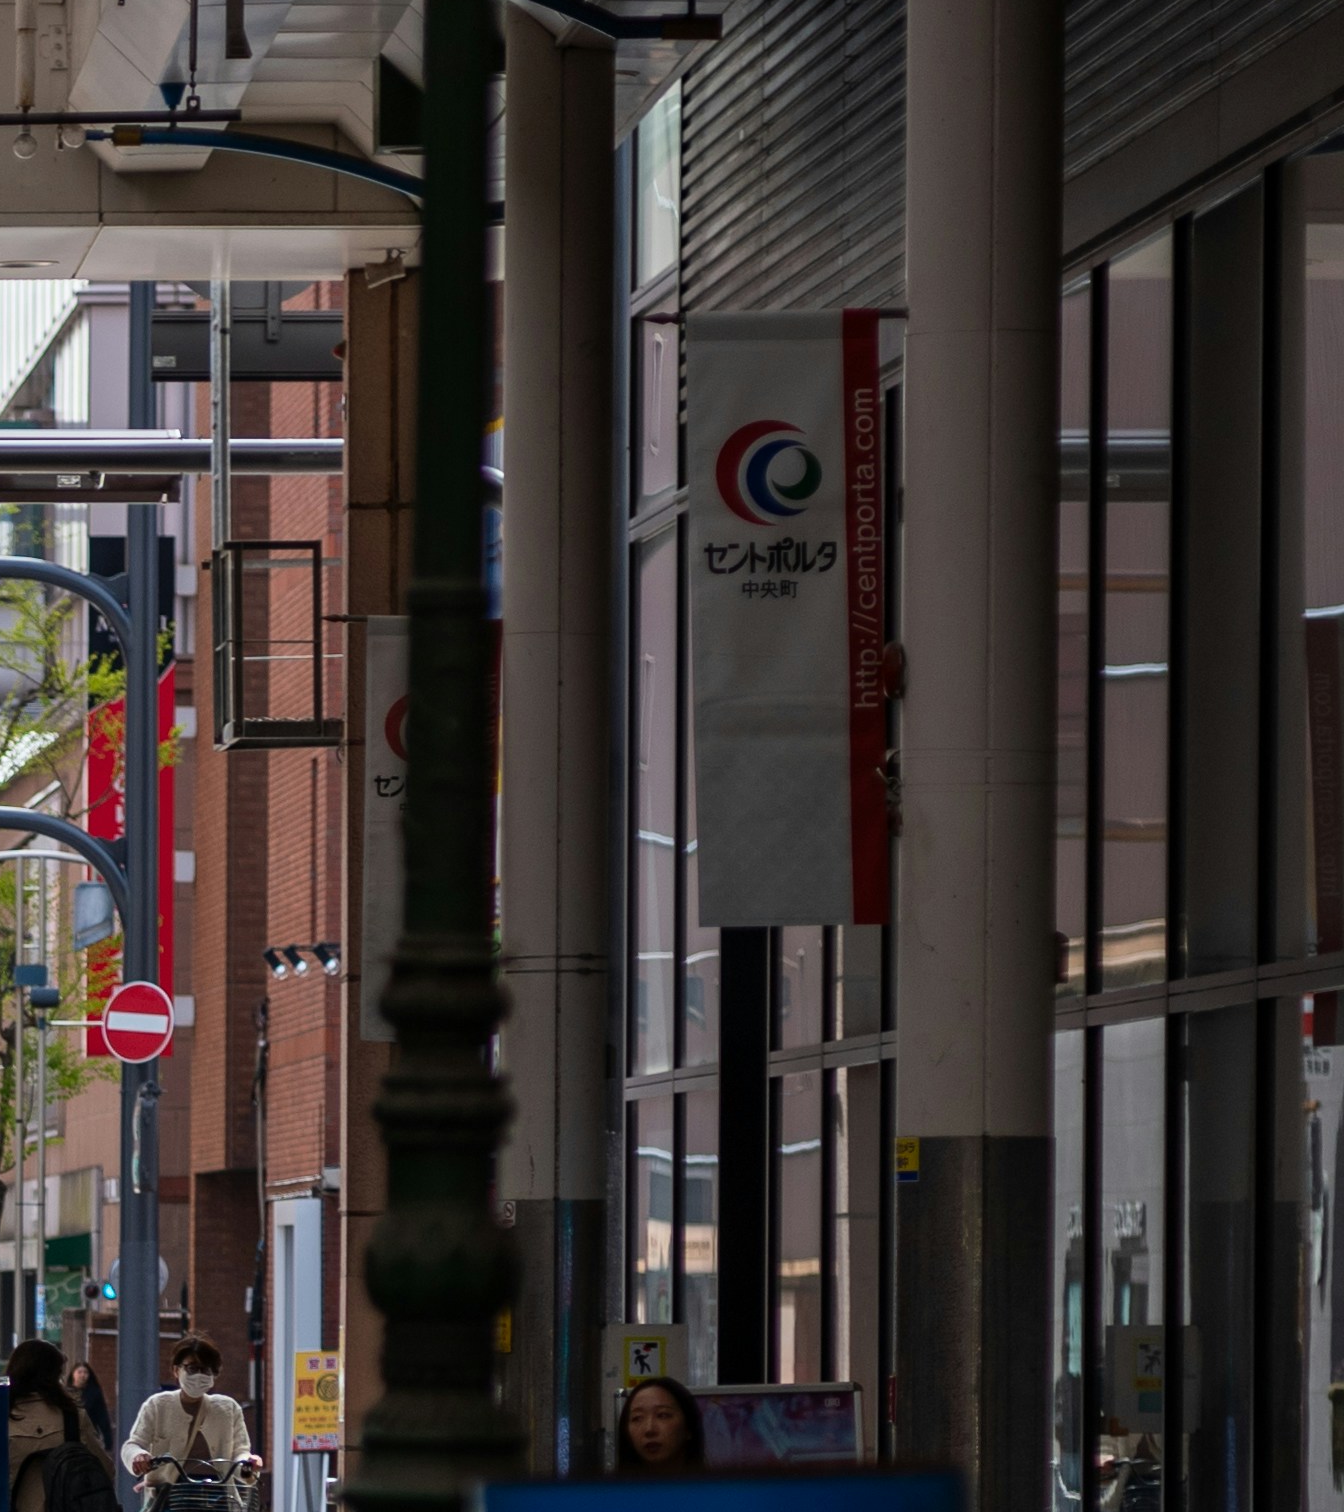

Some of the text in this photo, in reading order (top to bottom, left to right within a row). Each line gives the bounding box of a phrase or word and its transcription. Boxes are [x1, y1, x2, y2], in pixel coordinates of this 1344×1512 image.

[703, 535, 838, 574] セントポルタ
[852, 387, 884, 709] http://centporta.com
[741, 579, 799, 599] 中央町
